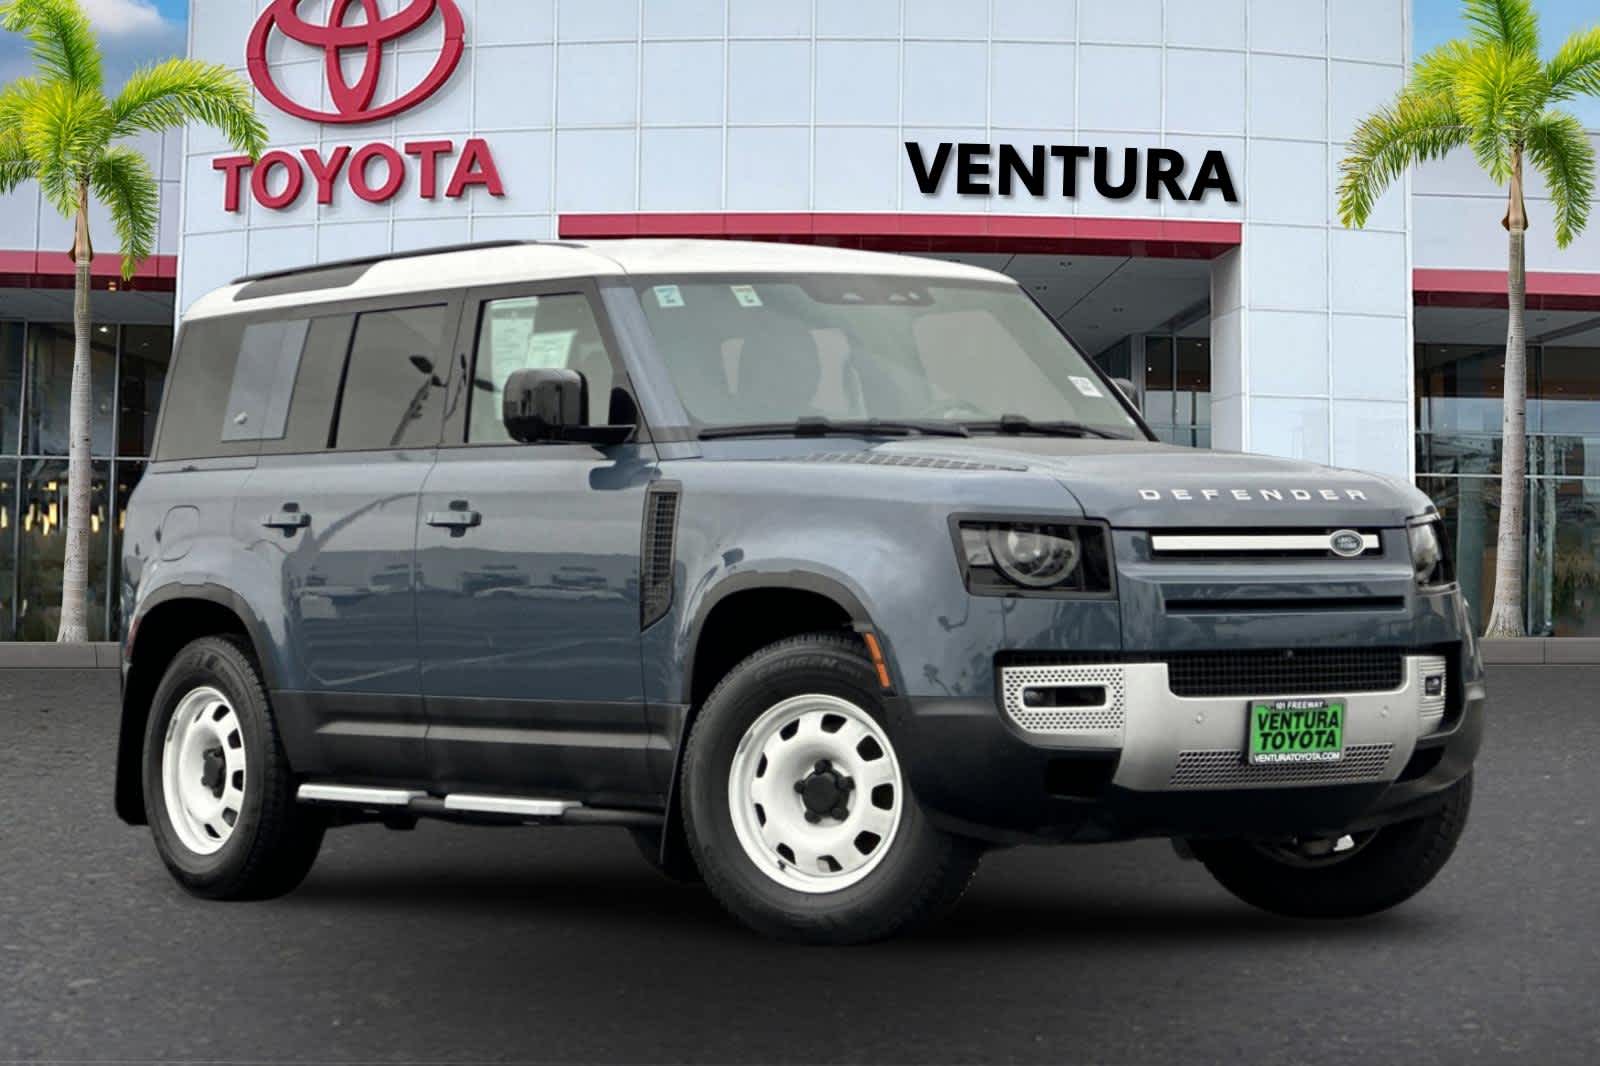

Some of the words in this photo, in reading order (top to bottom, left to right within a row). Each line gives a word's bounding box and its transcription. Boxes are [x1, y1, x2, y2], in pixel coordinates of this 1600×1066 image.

[212, 138, 505, 212] TOYOTA
[904, 142, 1238, 203] VENTURA
[1137, 488, 1368, 502] DEFENDER
[1257, 710, 1340, 731] VENTURA
[1260, 729, 1338, 751] TOYOTA
